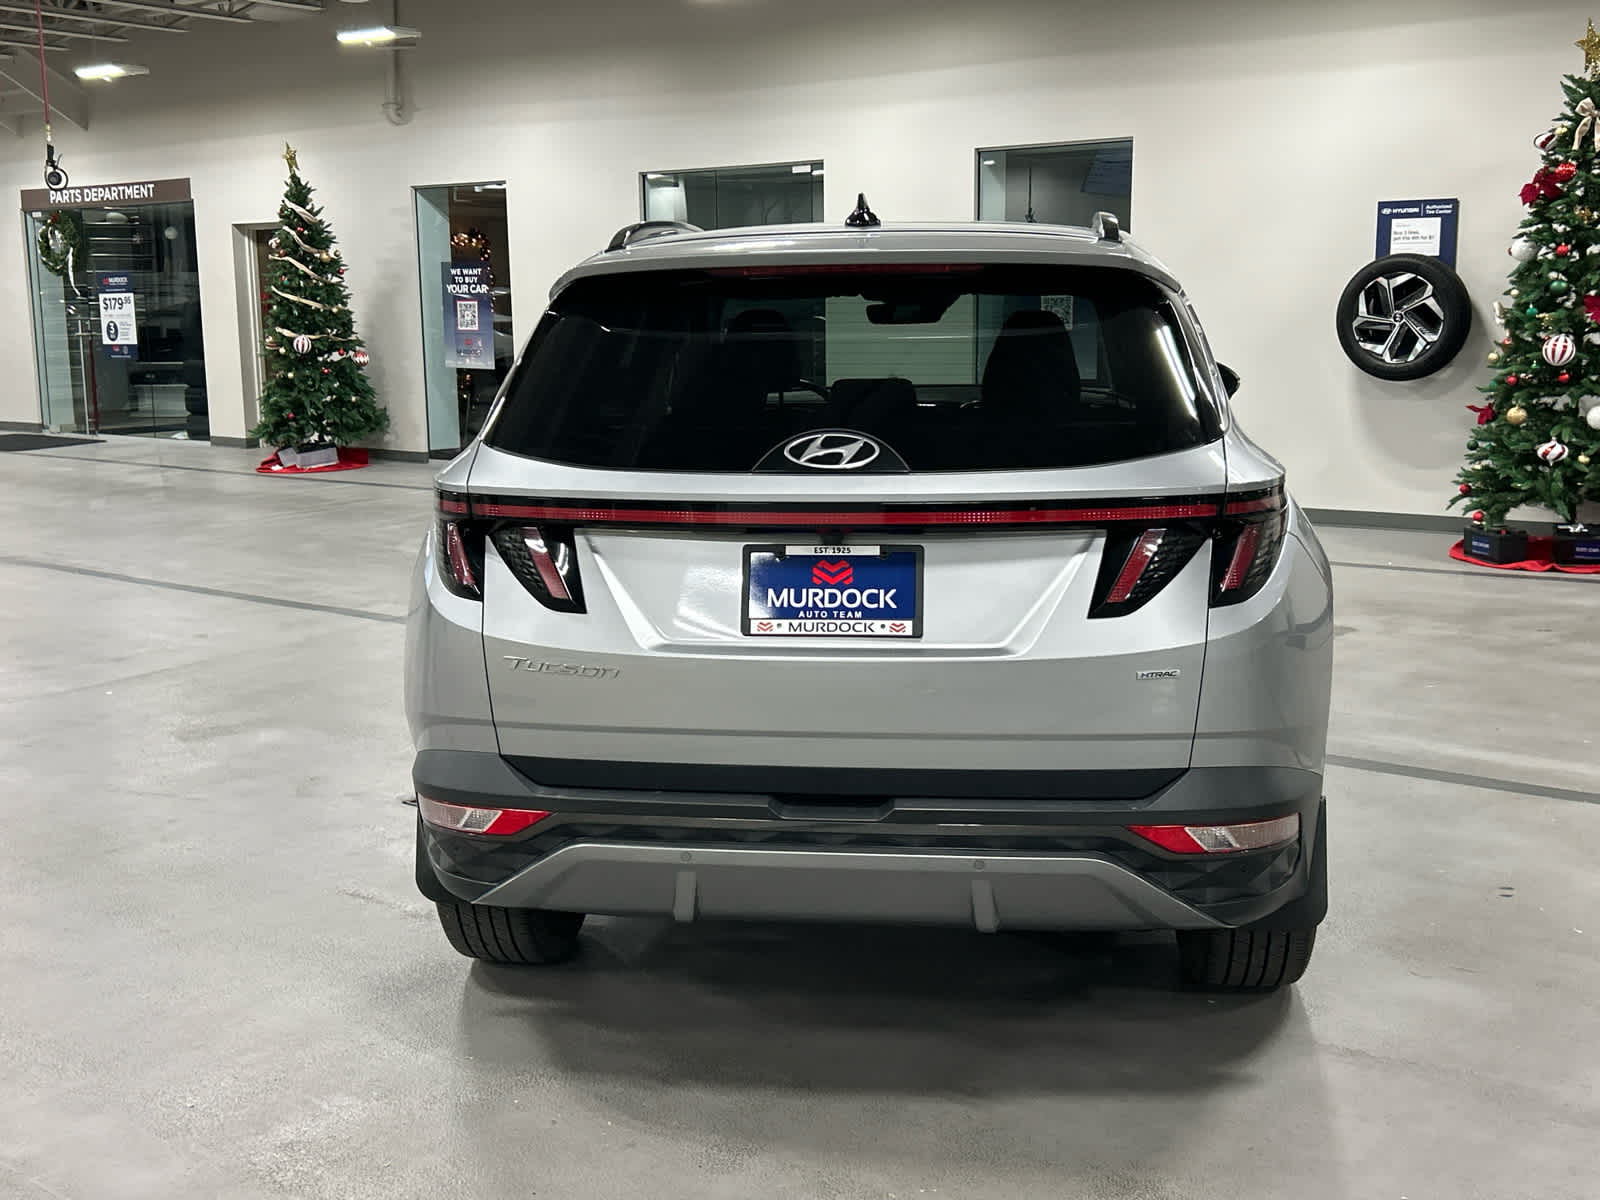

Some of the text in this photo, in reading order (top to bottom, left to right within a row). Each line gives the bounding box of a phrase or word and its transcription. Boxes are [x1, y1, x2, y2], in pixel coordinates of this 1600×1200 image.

[50, 184, 155, 203] PARTS DEPARTMENT
[446, 284, 489, 294] YOUR CAR
[767, 588, 897, 608] MURDOCK
[798, 610, 862, 618] AUTO TEAM
[788, 622, 875, 633] MURDOCK
